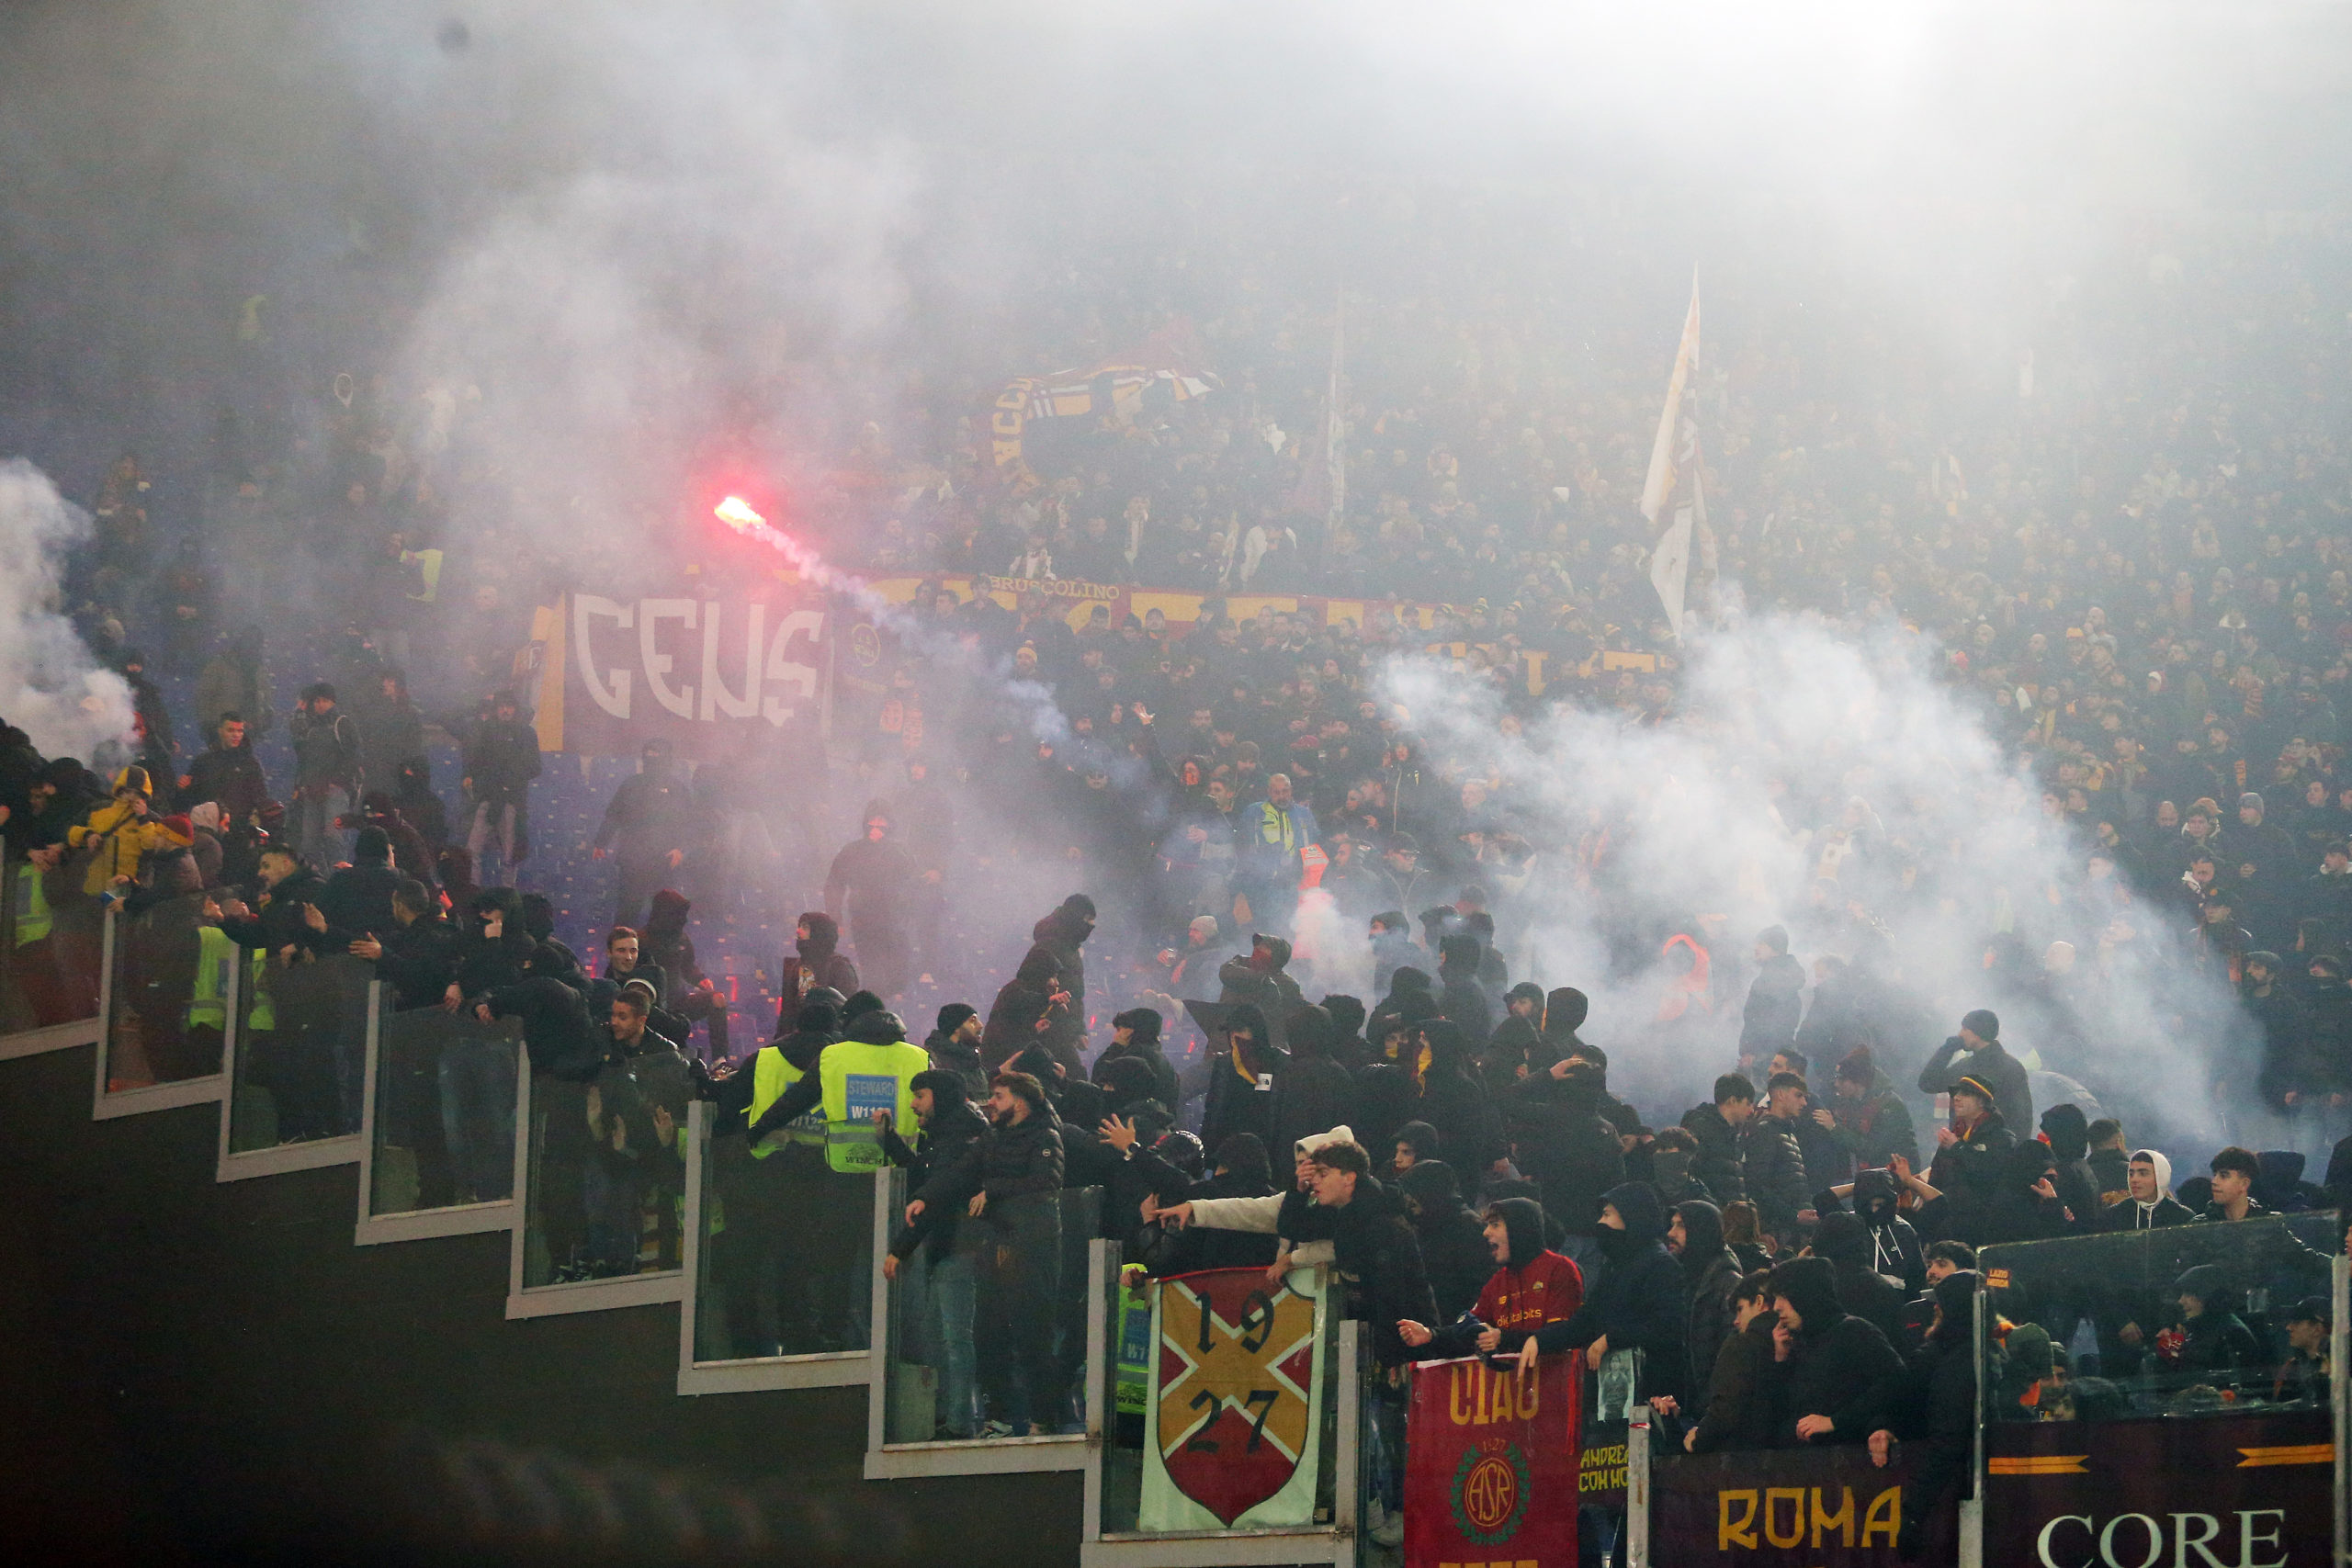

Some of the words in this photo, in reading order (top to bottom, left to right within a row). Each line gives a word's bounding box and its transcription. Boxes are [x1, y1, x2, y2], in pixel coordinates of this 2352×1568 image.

[848, 1080, 895, 1096] STEWARD
[1497, 1308, 1543, 1328] digtalbits
[1450, 1362, 1540, 1425] CIAO
[1718, 1485, 1901, 1551] ROMA
[2037, 1509, 2290, 1568] CORE
